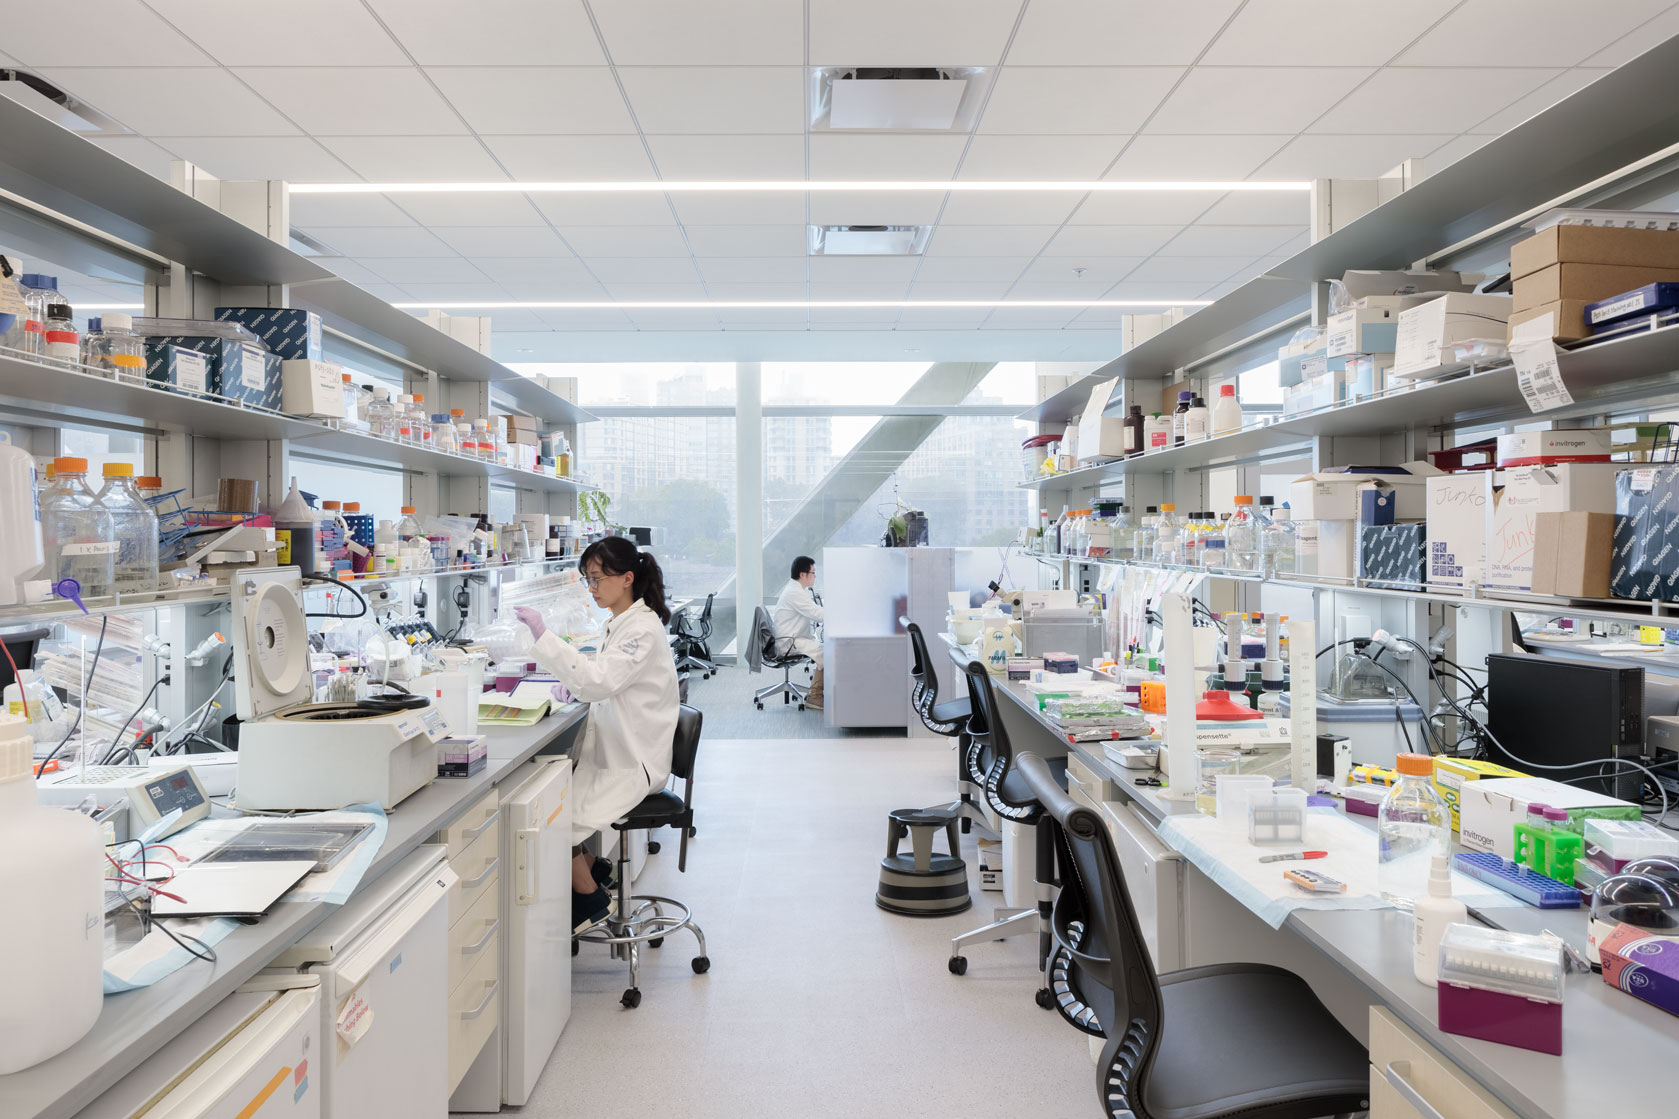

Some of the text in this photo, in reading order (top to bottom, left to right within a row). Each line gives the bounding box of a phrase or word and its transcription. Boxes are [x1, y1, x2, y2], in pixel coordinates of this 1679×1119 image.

[249, 314, 265, 328] QIAGEN
[282, 319, 298, 334] QIAGEN
[262, 326, 278, 340] QIAGEN
[275, 338, 290, 352] QIAGEN
[146, 358, 164, 375] QIAGEN
[1436, 486, 1486, 506] Junko
[1652, 491, 1672, 516] QIAGEN
[1630, 504, 1649, 528] QIAGEN
[1640, 522, 1660, 546] QIAGEN
[1620, 535, 1637, 558] QIAGEN
[1652, 542, 1672, 566] QIAGEN
[1612, 565, 1626, 587] QIAGEN
[1630, 554, 1648, 577] QIAGEN
[1646, 574, 1661, 597] QIAGEN
[1462, 828, 1495, 846] invitrogen
